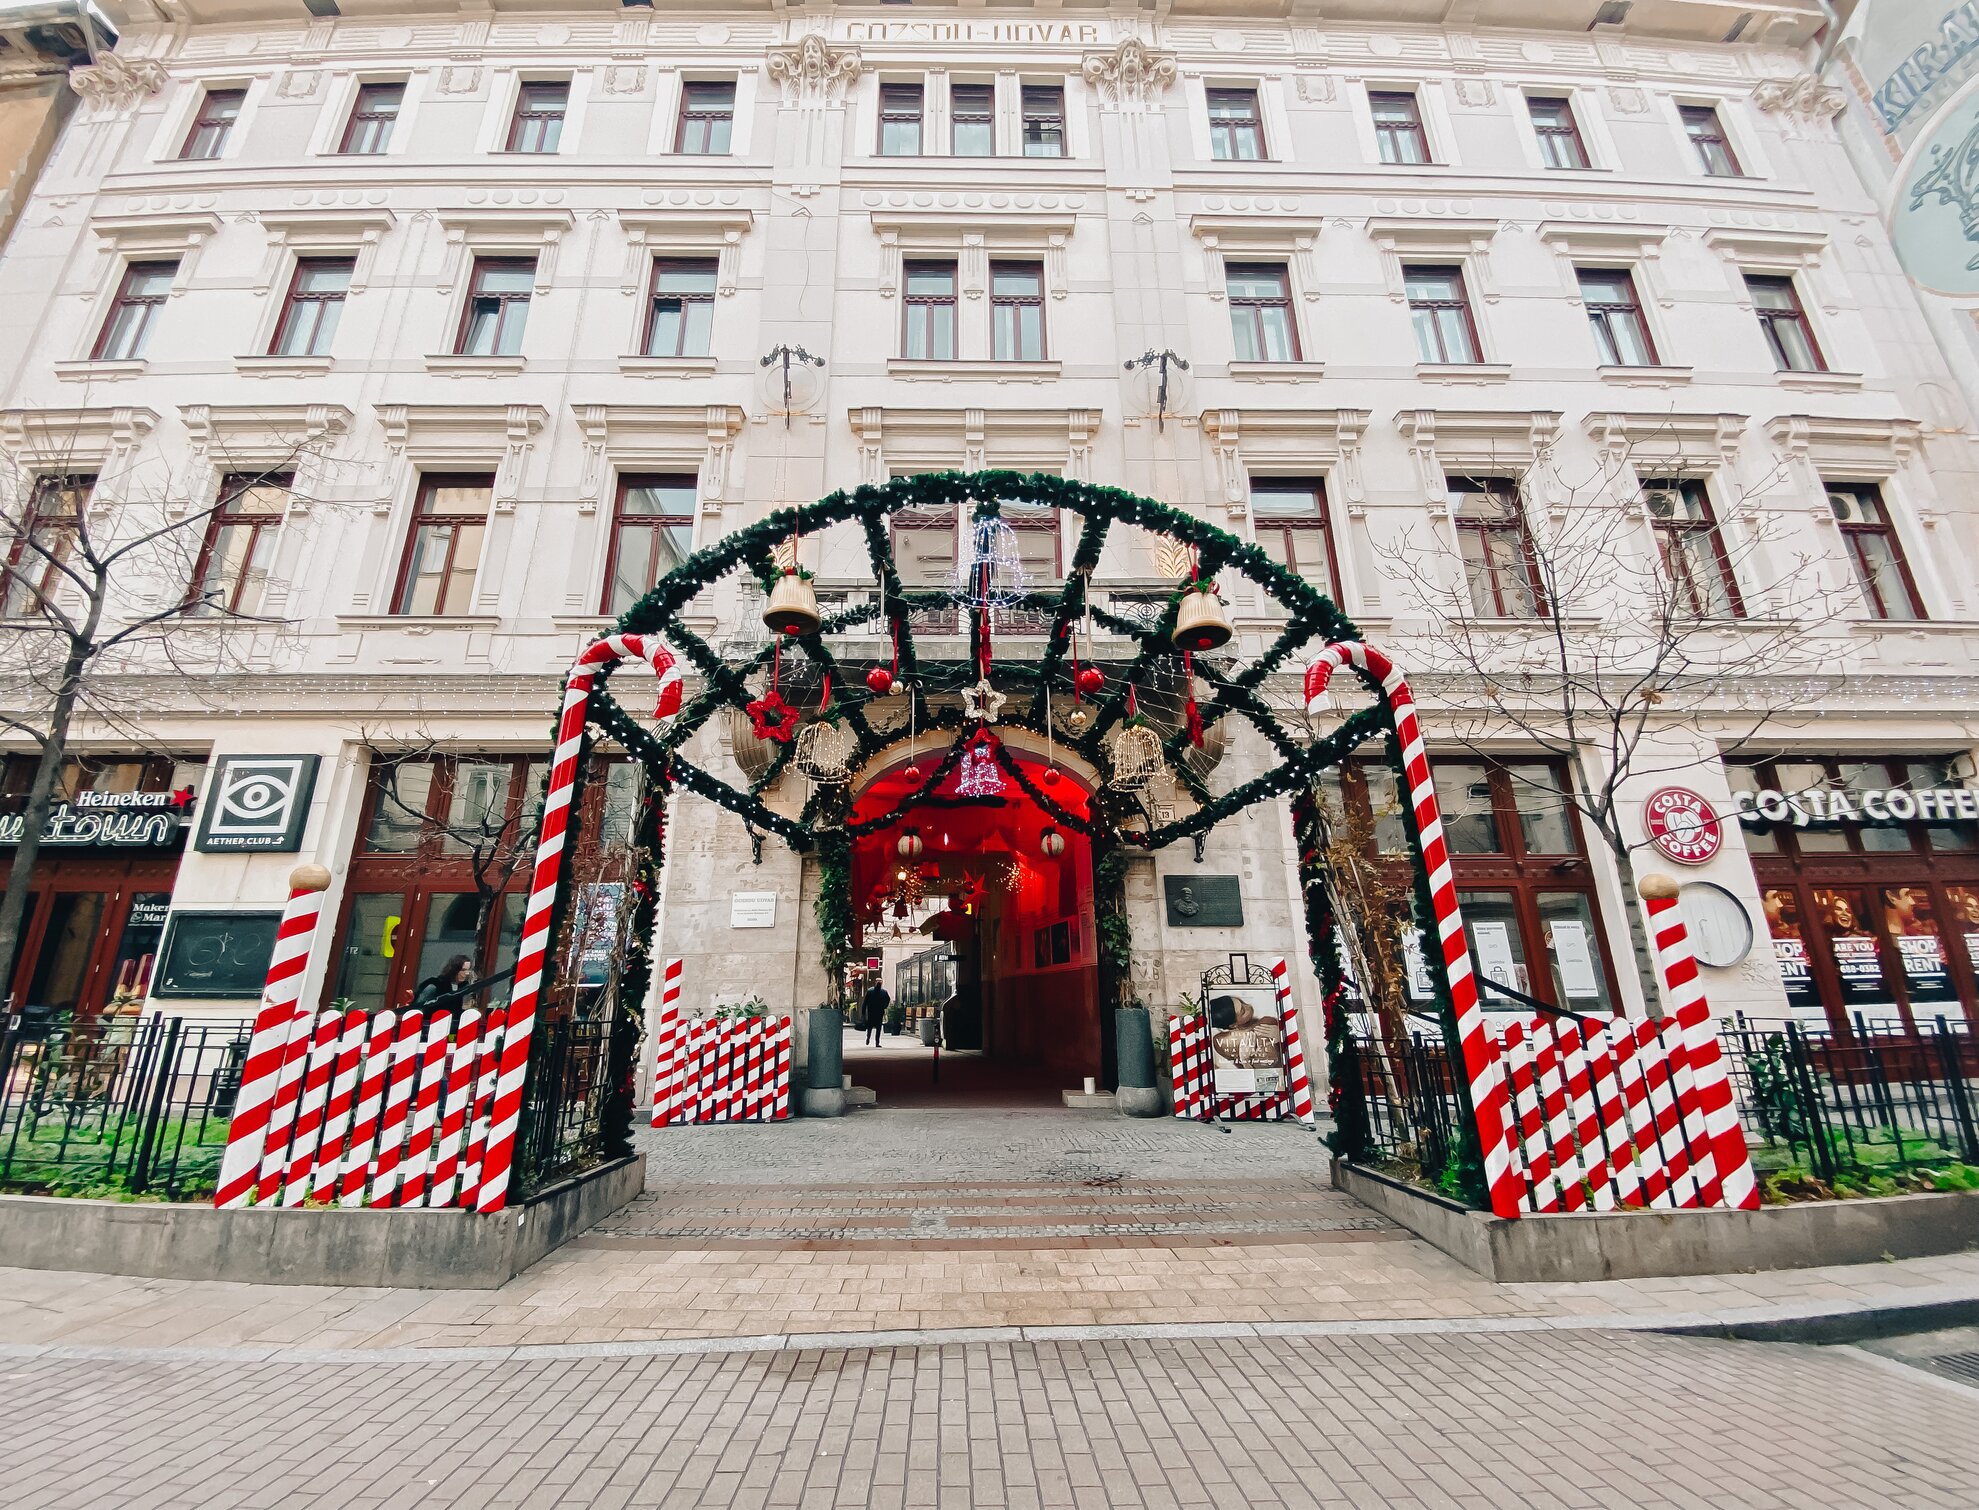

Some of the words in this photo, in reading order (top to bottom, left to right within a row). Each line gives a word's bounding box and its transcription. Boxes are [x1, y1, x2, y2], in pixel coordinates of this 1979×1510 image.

[77, 791, 166, 806] Heineken
[1654, 793, 1702, 814] COSTA
[1732, 789, 1858, 827] COSTA
[1862, 788, 1979, 820] COFFE
[206, 837, 246, 845] AETHER
[246, 837, 272, 845] CLUB
[1659, 832, 1718, 857] COFFEE
[132, 903, 170, 911] Maker
[142, 913, 167, 922] Mar
[1773, 943, 1803, 957] HOP
[1834, 943, 1853, 952] ARE
[1853, 942, 1875, 952] YOU
[1898, 939, 1937, 954] SHOP
[1779, 962, 1807, 976] ENT
[1903, 957, 1942, 973] RENT
[1215, 1037, 1276, 1048] VITALITY
